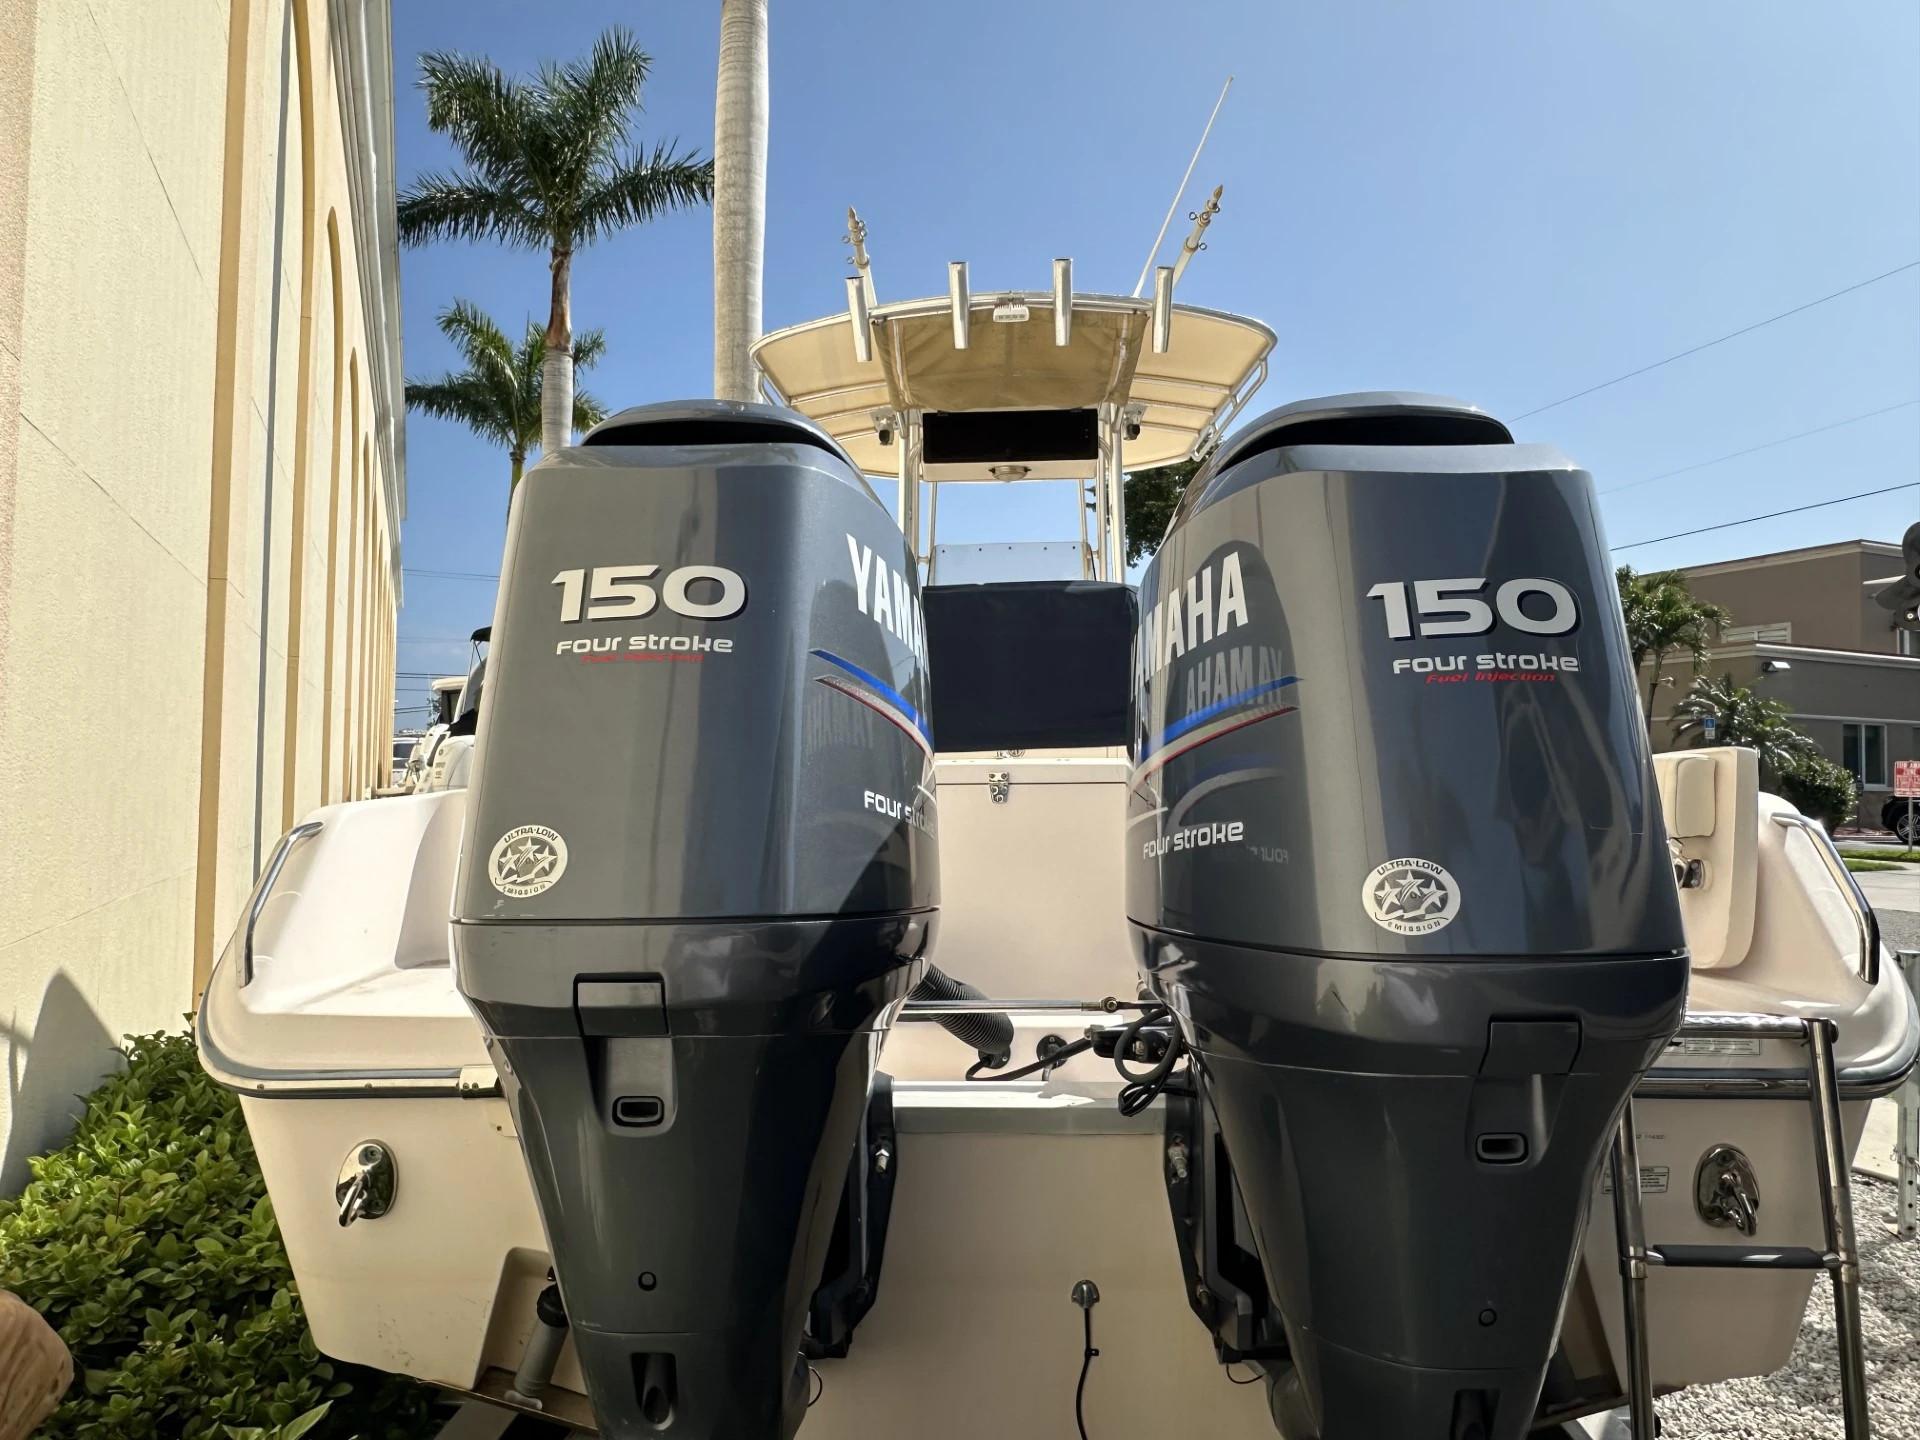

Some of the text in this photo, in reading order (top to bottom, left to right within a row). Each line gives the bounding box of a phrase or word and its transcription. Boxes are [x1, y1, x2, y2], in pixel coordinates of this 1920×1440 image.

[551, 564, 747, 623] 150
[846, 532, 930, 675] YAMA
[1366, 577, 1580, 640] 150
[1131, 551, 1249, 703] YAMAHA
[1424, 672, 1470, 685] Fuel
